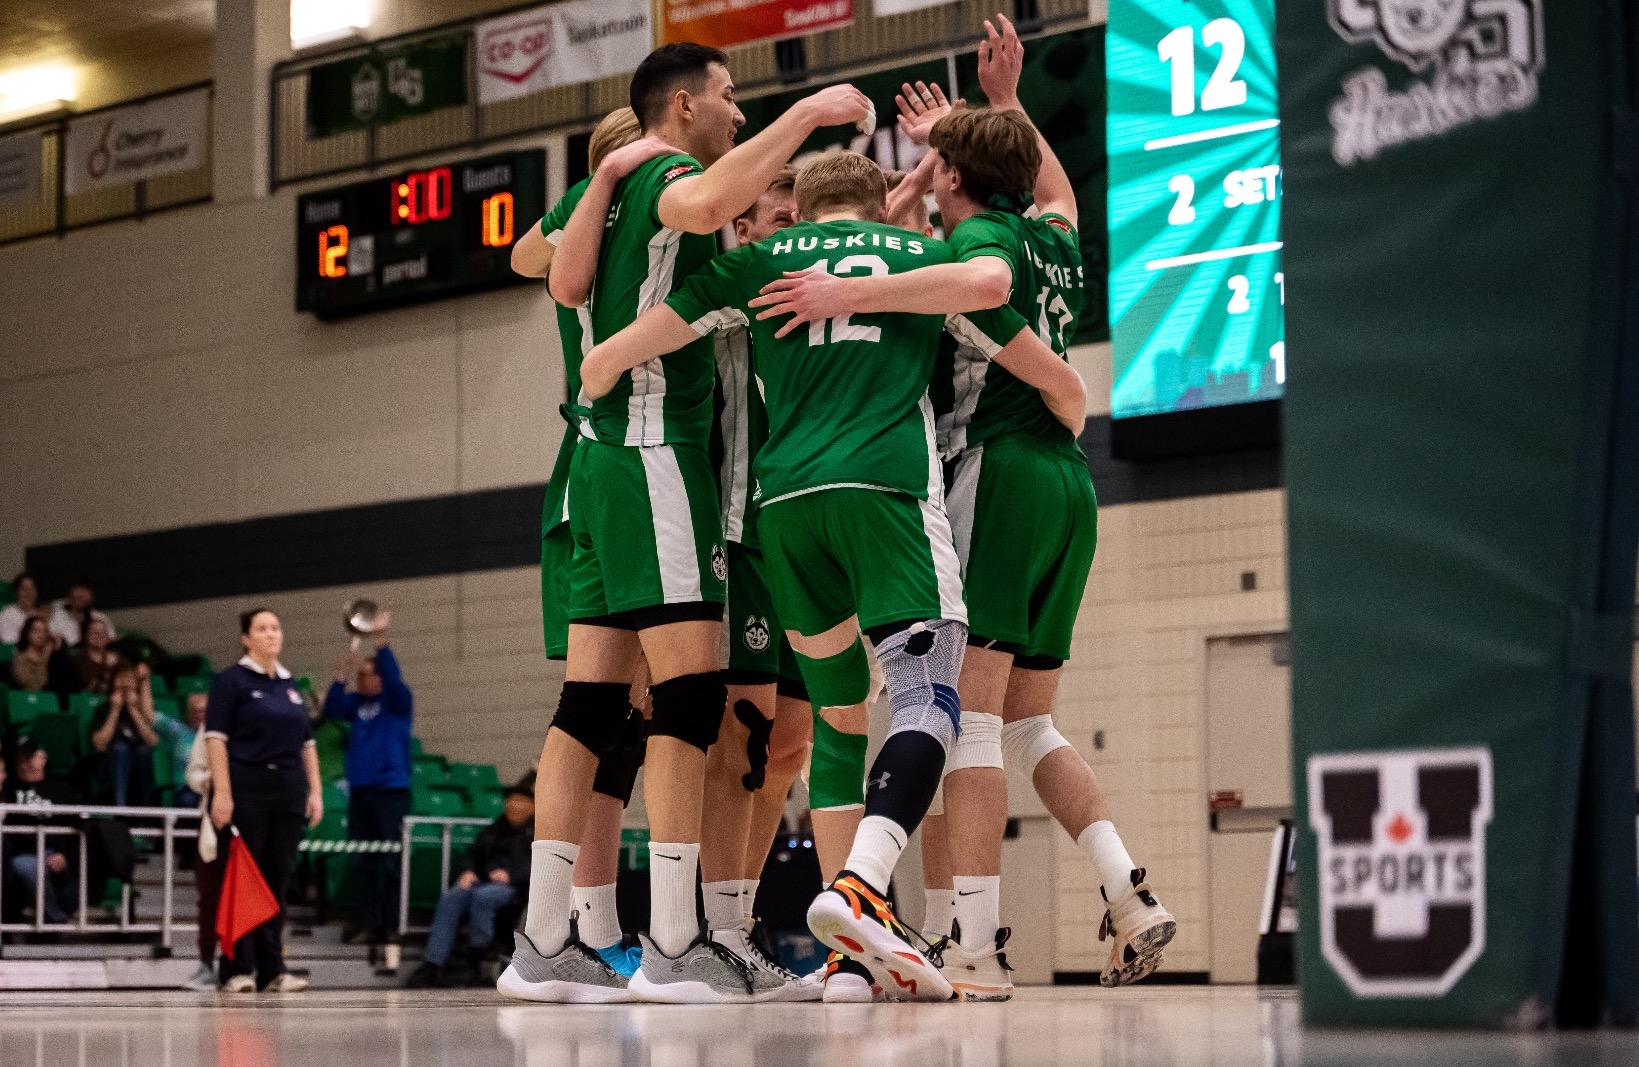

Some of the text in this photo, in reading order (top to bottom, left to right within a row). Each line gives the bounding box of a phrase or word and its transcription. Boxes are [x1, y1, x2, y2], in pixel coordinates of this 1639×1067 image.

[1158, 18, 1247, 116] 12
[1168, 164, 1283, 225] 2 SET
[772, 232, 924, 256] HUSKIES
[800, 254, 890, 347] 12
[1227, 274, 1250, 315] 2
[1329, 851, 1475, 894] SPORTS
